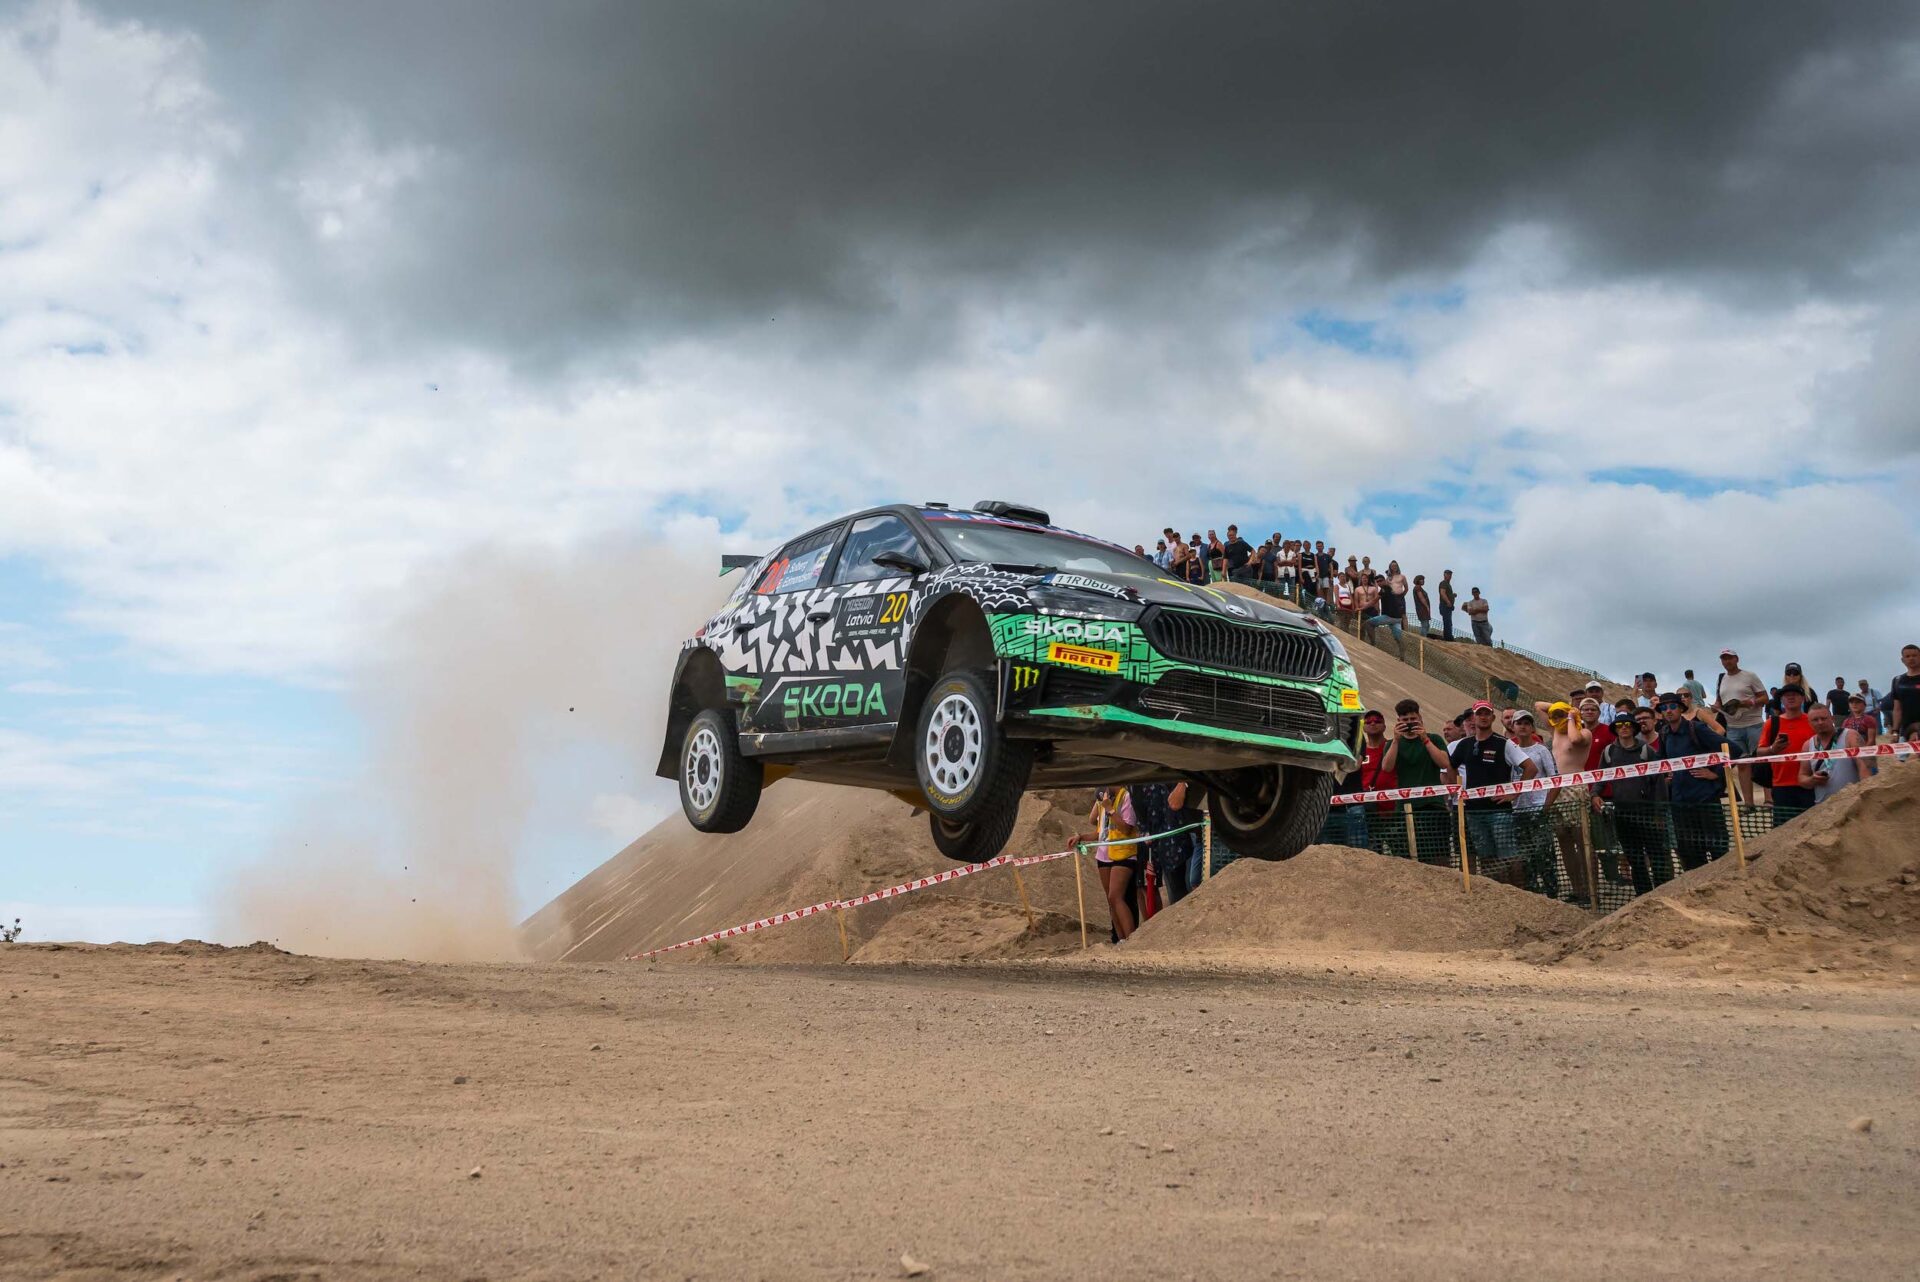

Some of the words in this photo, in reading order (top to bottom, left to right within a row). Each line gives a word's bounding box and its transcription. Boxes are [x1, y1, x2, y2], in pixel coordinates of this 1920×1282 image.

[757, 557, 790, 594] 20
[846, 611, 875, 627] Latvia
[880, 592, 908, 624] 20
[1055, 646, 1114, 668] PIRELLI
